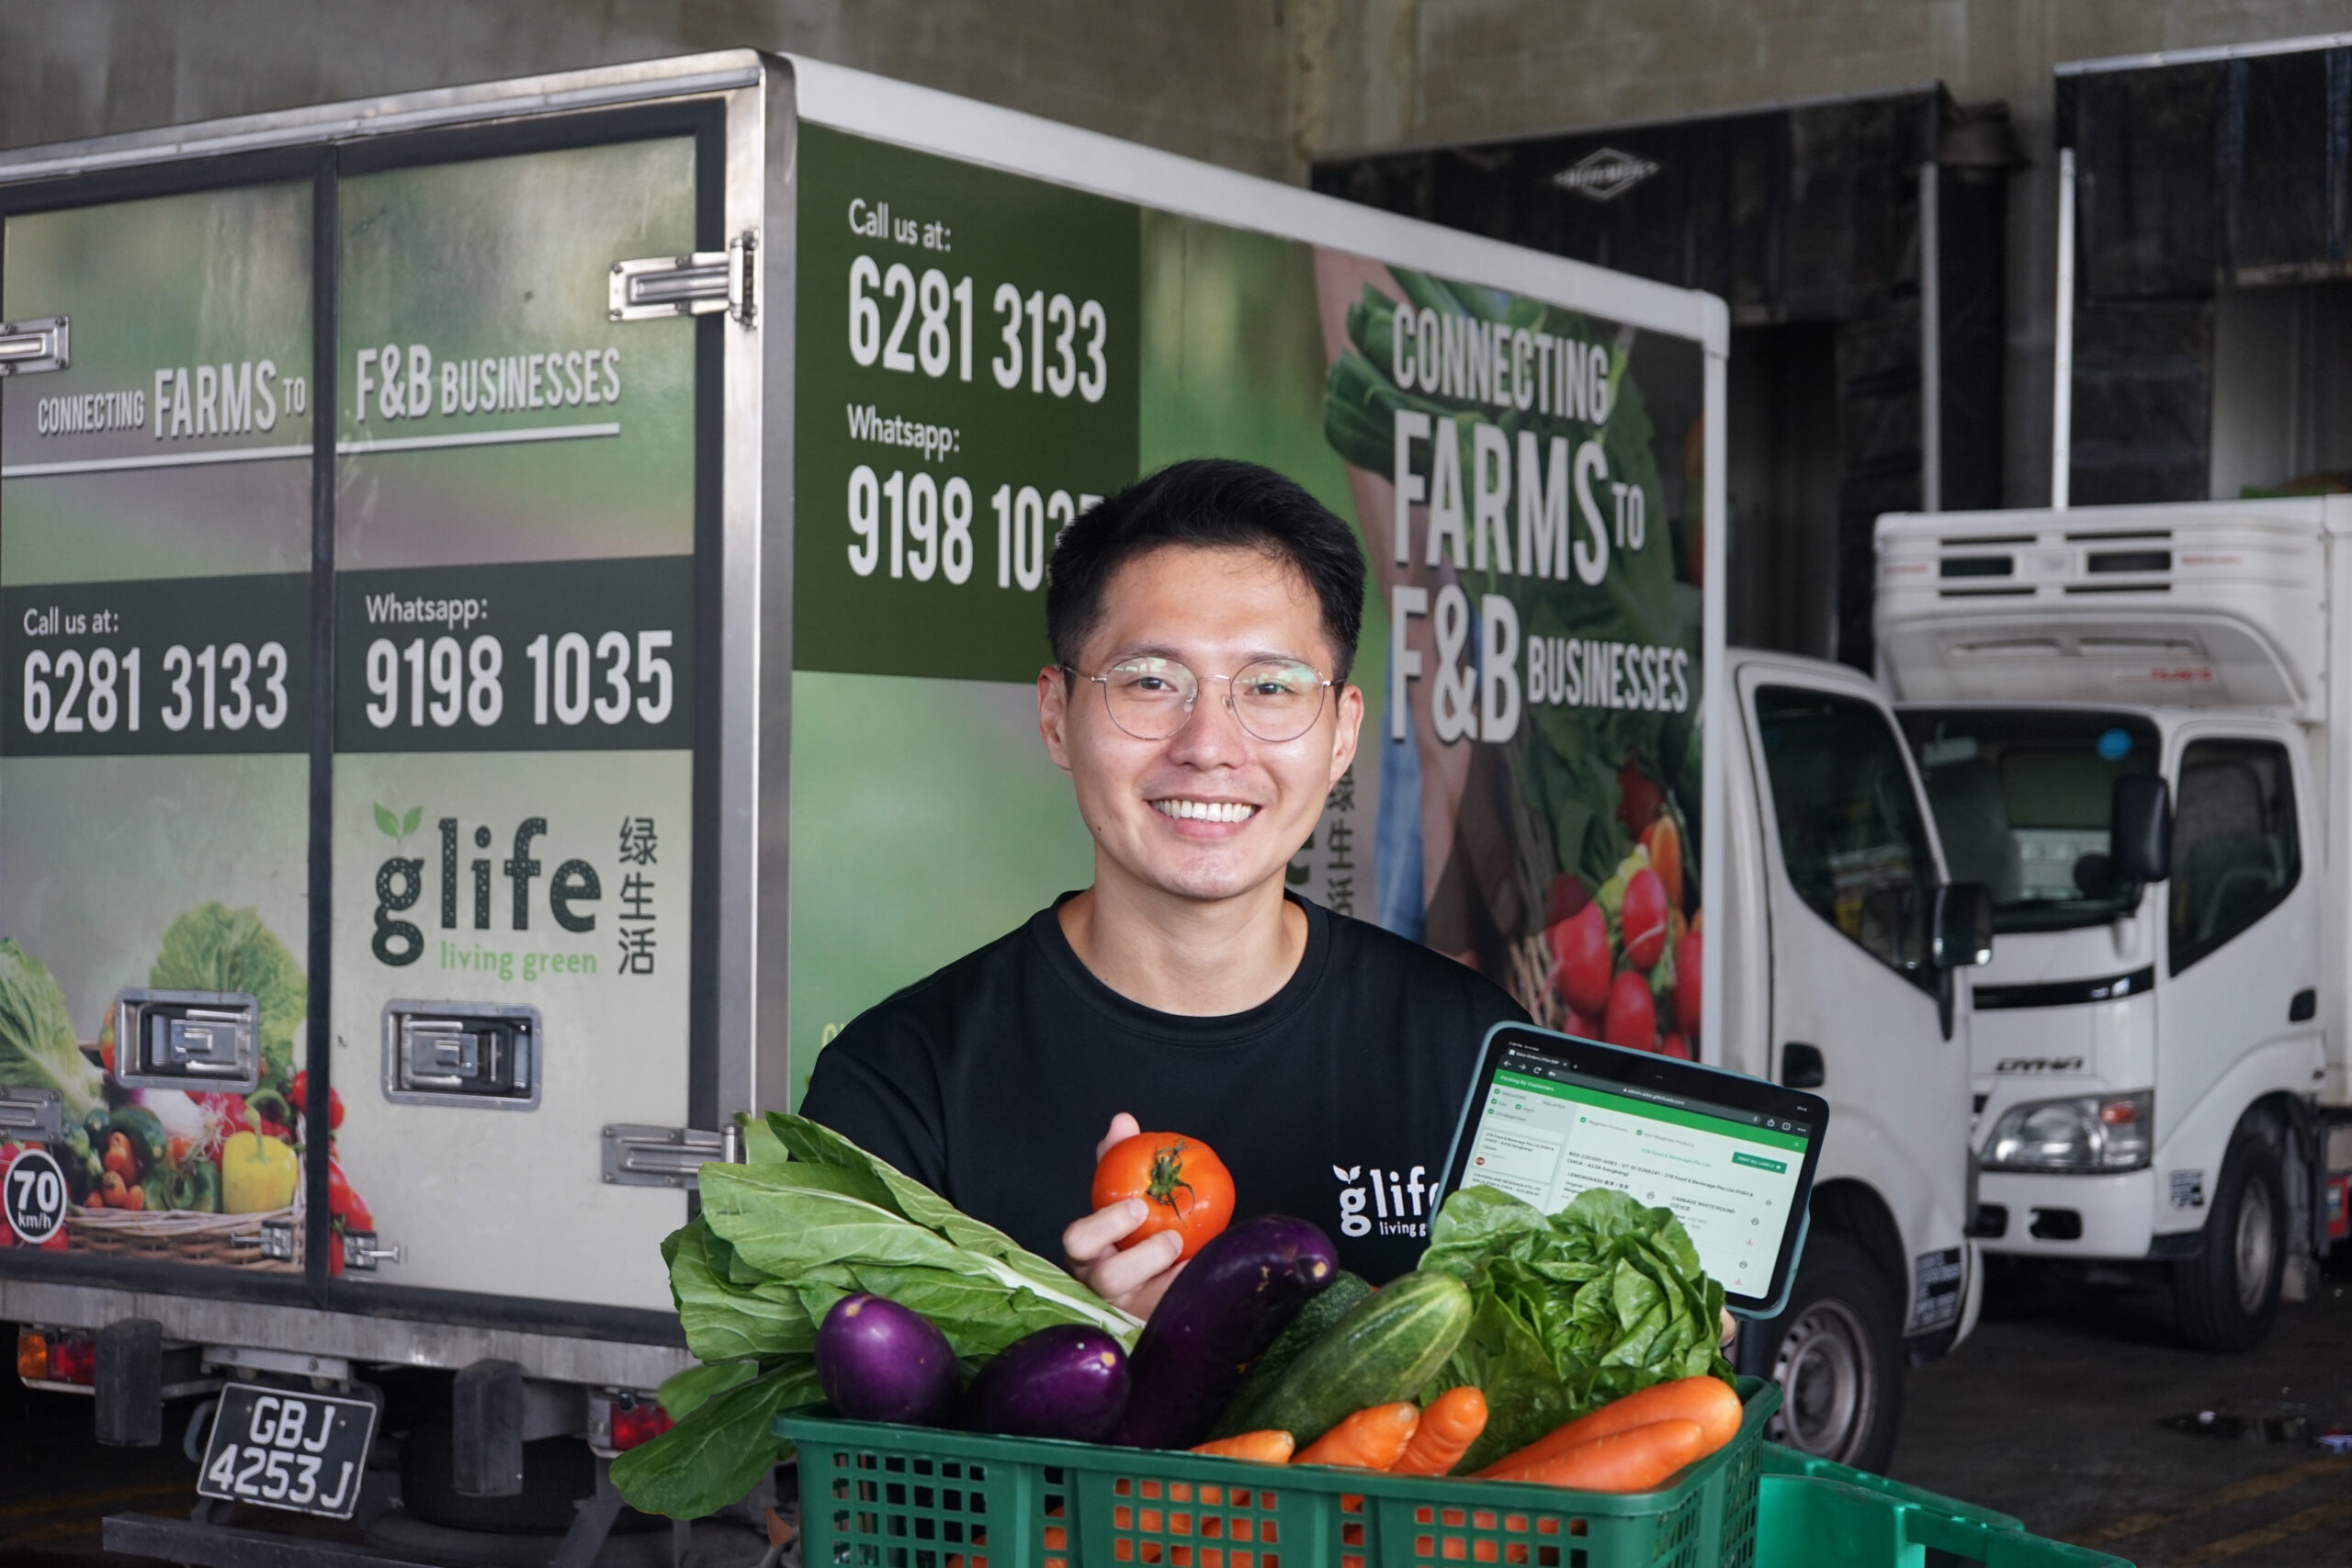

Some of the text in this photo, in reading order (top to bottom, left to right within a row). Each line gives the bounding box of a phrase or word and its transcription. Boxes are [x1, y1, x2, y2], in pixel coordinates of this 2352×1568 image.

[848, 198, 951, 252] Call us at:
[848, 254, 1107, 403] 6281 3133
[1392, 302, 1609, 425] CONNECTING
[38, 344, 620, 439] CONNECTING FARMS TO F&B BUSINESSES
[847, 403, 960, 462] Whatsapp:
[848, 465, 1105, 592] 9198 10
[1394, 409, 1645, 586] FARMS TO
[23, 609, 119, 636] Call us at:
[366, 594, 488, 627] Whatsapp:
[23, 643, 288, 733] 6281 3133
[366, 631, 673, 728] 9198 1035
[1391, 583, 1689, 743] F&B BUSINESSES
[371, 818, 602, 966] glife
[618, 816, 658, 976] 绿生活
[441, 941, 596, 982] living green
[14, 1170, 60, 1212] 70
[17, 1212, 52, 1231] km/h
[1379, 1221, 1417, 1238] living
[251, 1396, 335, 1451] GBJ
